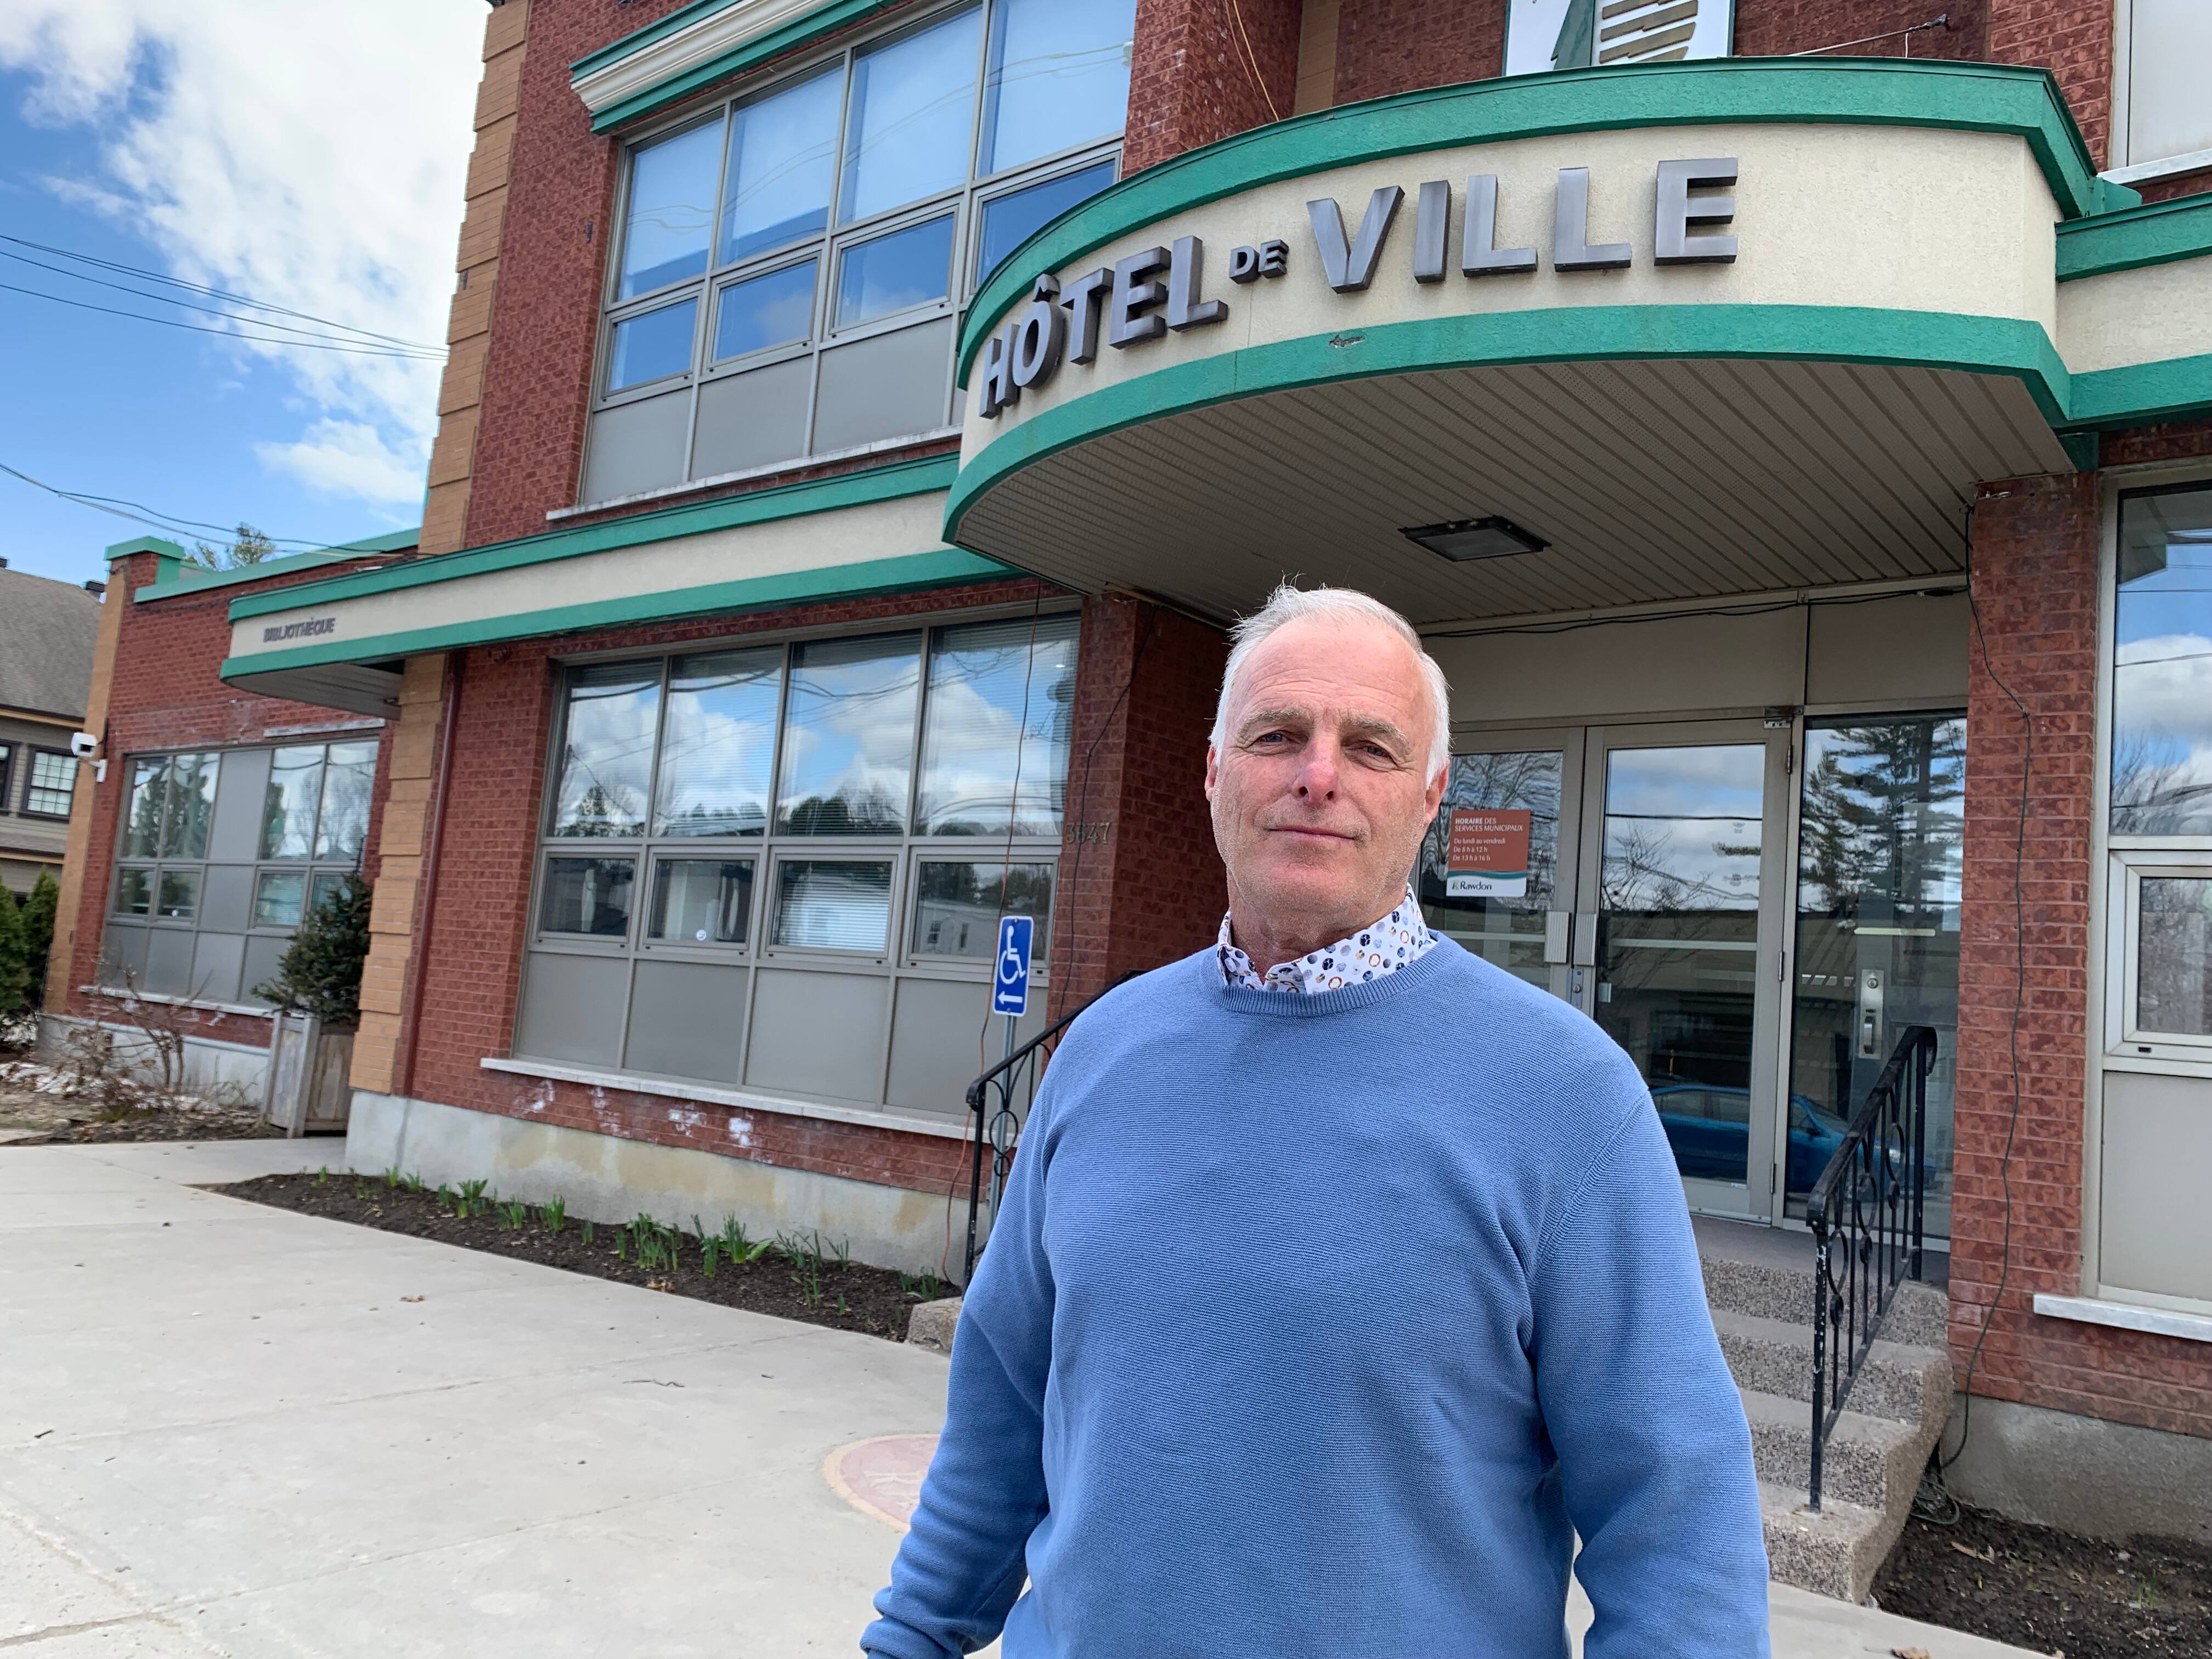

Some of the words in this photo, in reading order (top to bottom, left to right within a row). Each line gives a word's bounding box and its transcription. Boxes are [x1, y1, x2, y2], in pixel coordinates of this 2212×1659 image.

[979, 235, 1229, 419] HÔTEL
[1229, 239, 1289, 284] DE
[1306, 157, 1738, 294] VILLE
[263, 617, 336, 643] BIBLIOTHÈQUE
[1065, 822, 1111, 845] 3647
[1460, 881, 1492, 890] Rawdon
